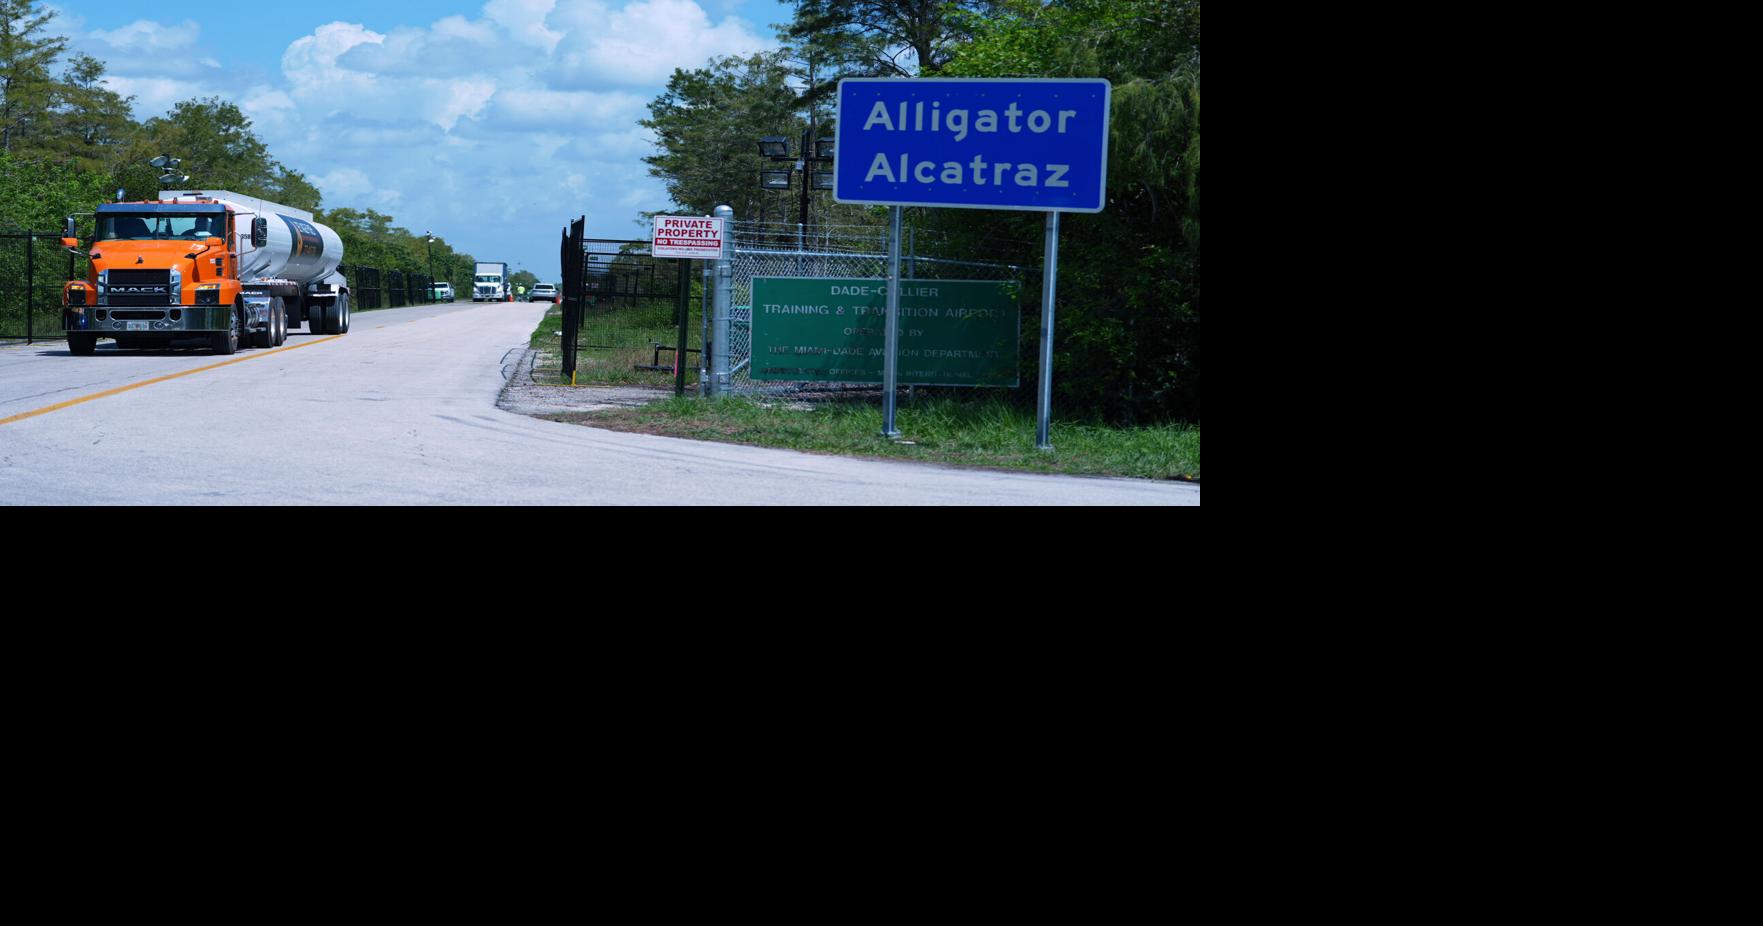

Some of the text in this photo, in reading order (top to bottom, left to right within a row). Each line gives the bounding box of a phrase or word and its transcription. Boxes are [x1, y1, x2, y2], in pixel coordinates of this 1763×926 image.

[863, 101, 1077, 142] Alligator
[864, 152, 1070, 188] Alcatraz
[664, 219, 713, 229] PRIVATE
[657, 228, 719, 238] PROPERTY
[669, 239, 719, 247] TRESPASSING
[831, 285, 939, 298] DADE-CLLIER
[763, 303, 829, 315] TRAINING
[835, 305, 846, 316] &
[852, 304, 938, 318] TRANITION
[908, 328, 925, 337] BY
[868, 347, 919, 357] AVION
